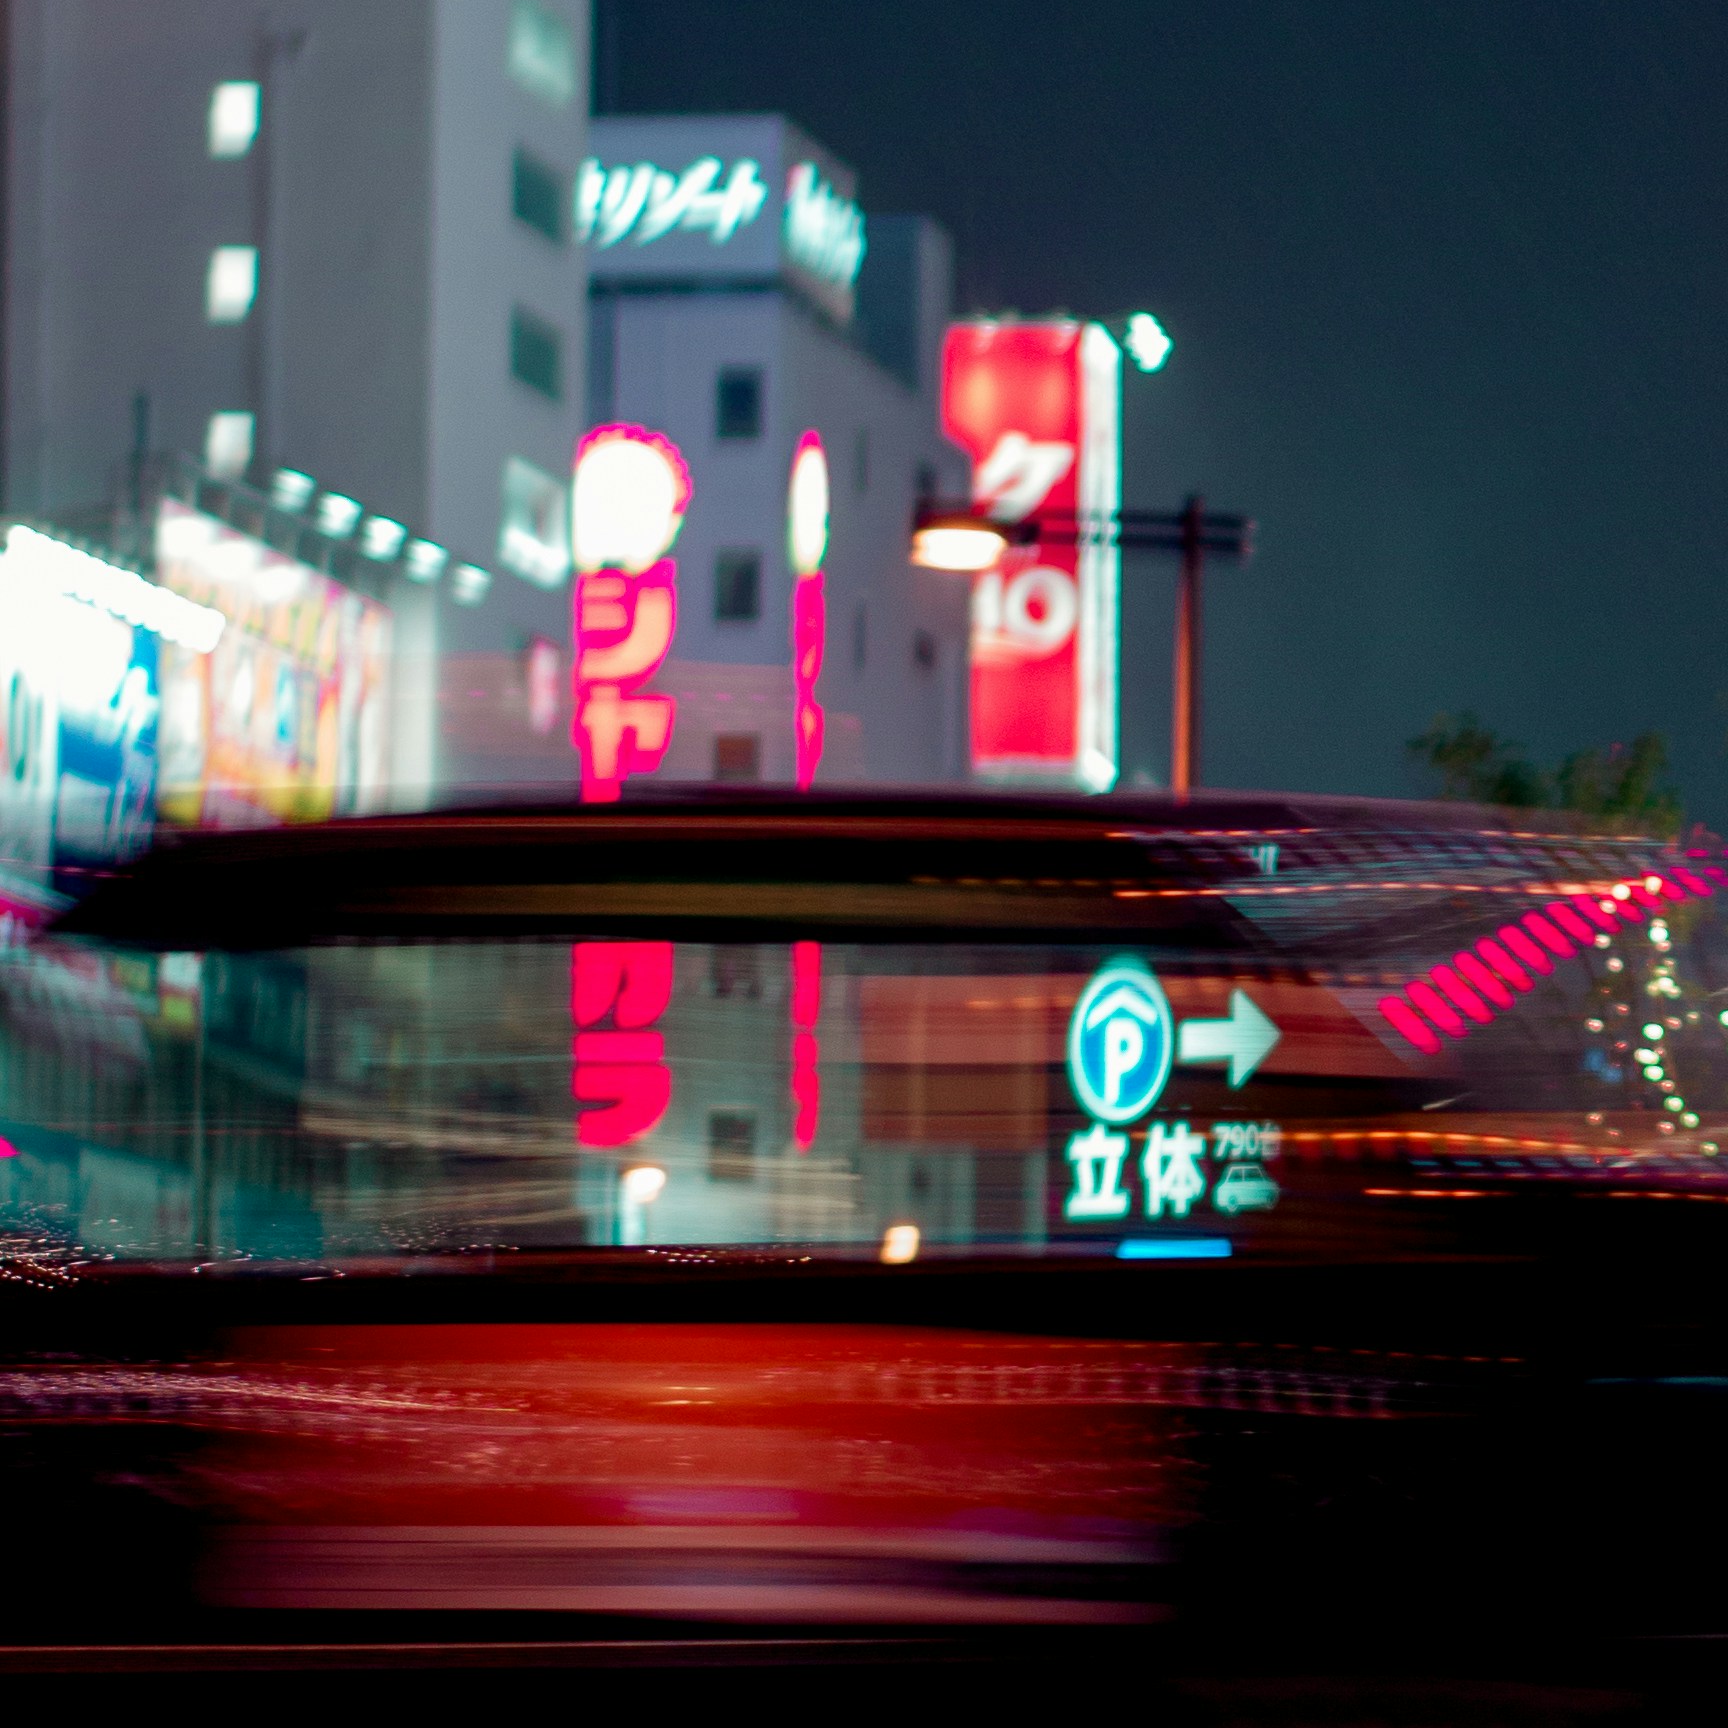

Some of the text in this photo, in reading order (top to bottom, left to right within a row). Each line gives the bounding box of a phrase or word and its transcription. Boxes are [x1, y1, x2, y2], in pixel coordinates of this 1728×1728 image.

[569, 556, 677, 1148] ジャカラ
[1065, 1122, 1207, 1220] 立体
